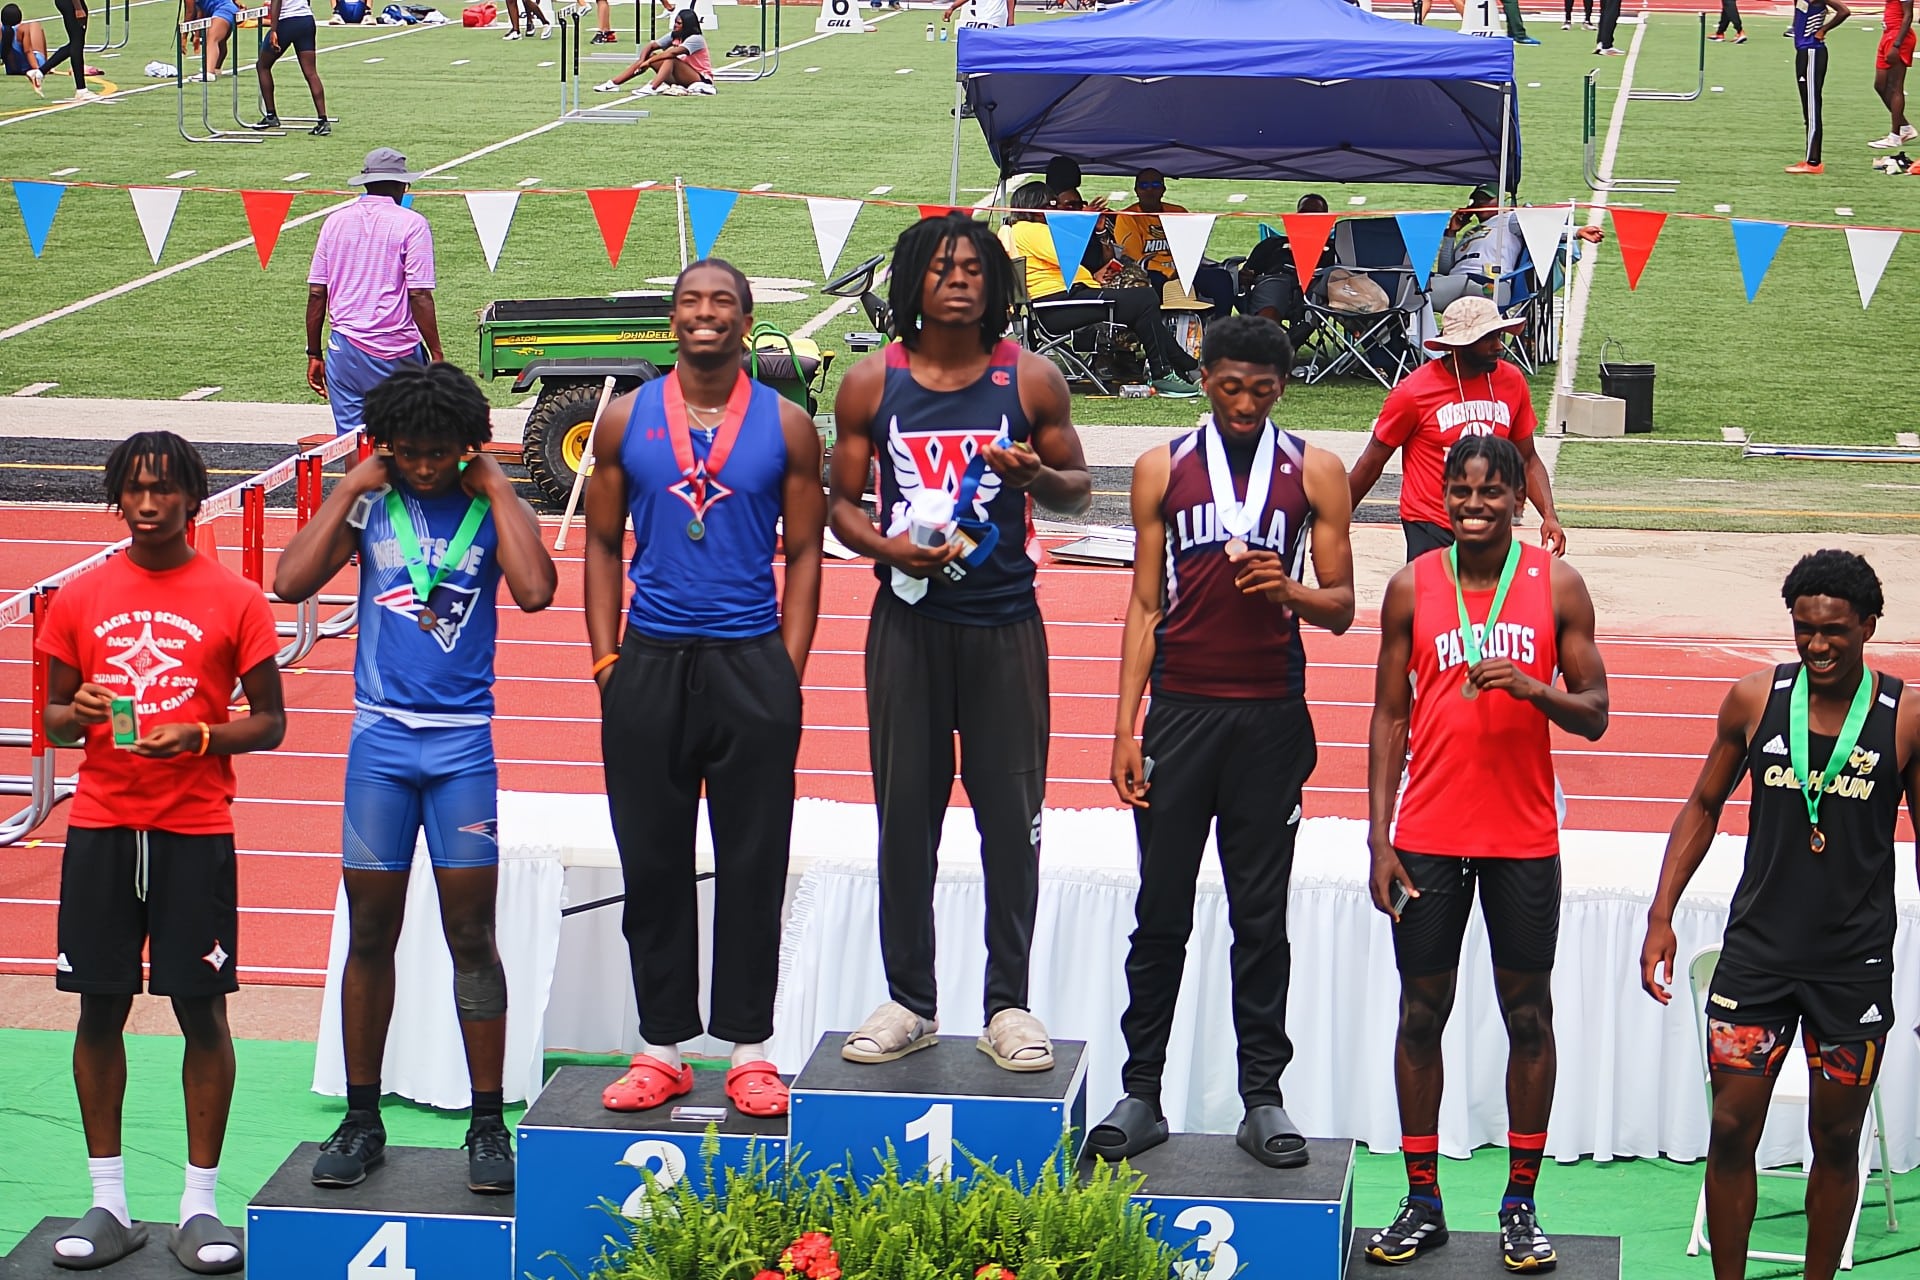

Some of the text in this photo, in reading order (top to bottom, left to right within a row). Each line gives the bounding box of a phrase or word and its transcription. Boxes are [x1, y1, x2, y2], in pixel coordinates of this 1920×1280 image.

[827, 19, 852, 27] GILL
[1477, 0, 1488, 26] 1
[616, 330, 646, 340] JOHN
[93, 610, 204, 642] BACK TO SCHOOL
[905, 1103, 953, 1183] 1
[620, 1139, 687, 1220] 2
[347, 1221, 416, 1280] 4
[1172, 1205, 1239, 1280] 3
